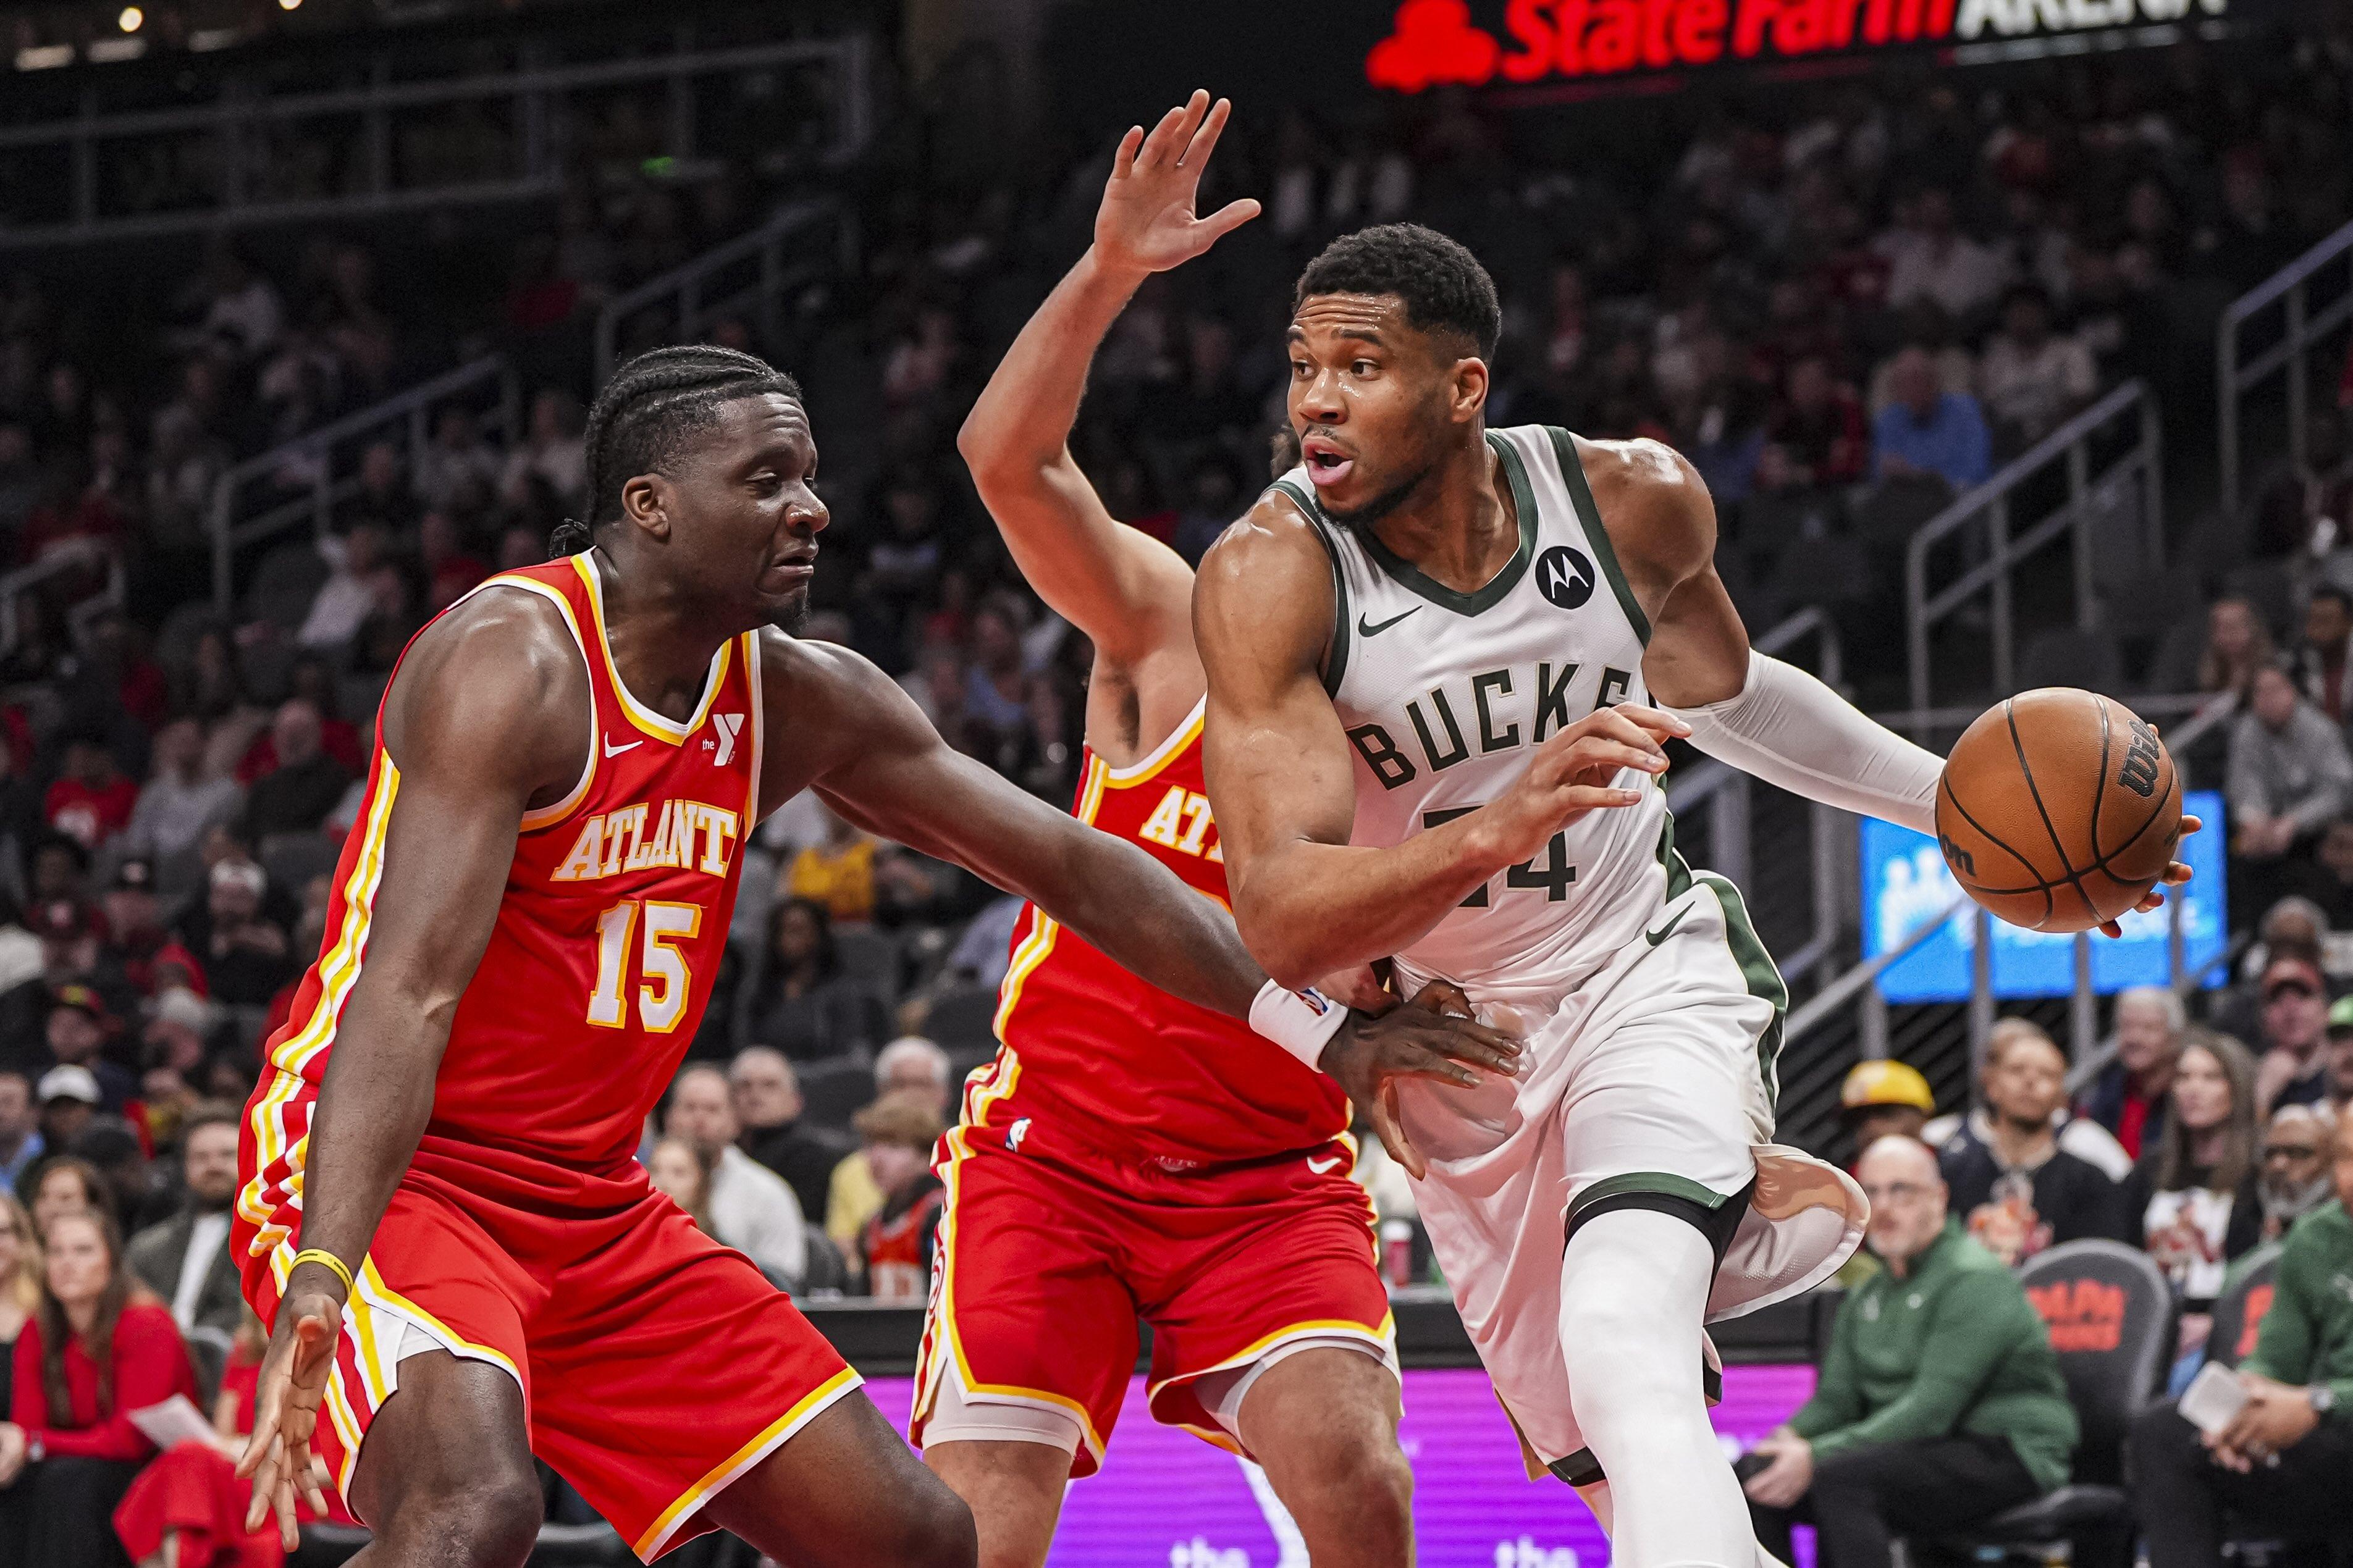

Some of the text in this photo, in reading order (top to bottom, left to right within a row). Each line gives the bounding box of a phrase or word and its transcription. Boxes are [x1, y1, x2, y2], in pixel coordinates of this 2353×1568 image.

[1502, 0, 1727, 82] State
[702, 739, 715, 750] the
[1421, 802, 1579, 908] 4
[586, 899, 702, 1033] 15
